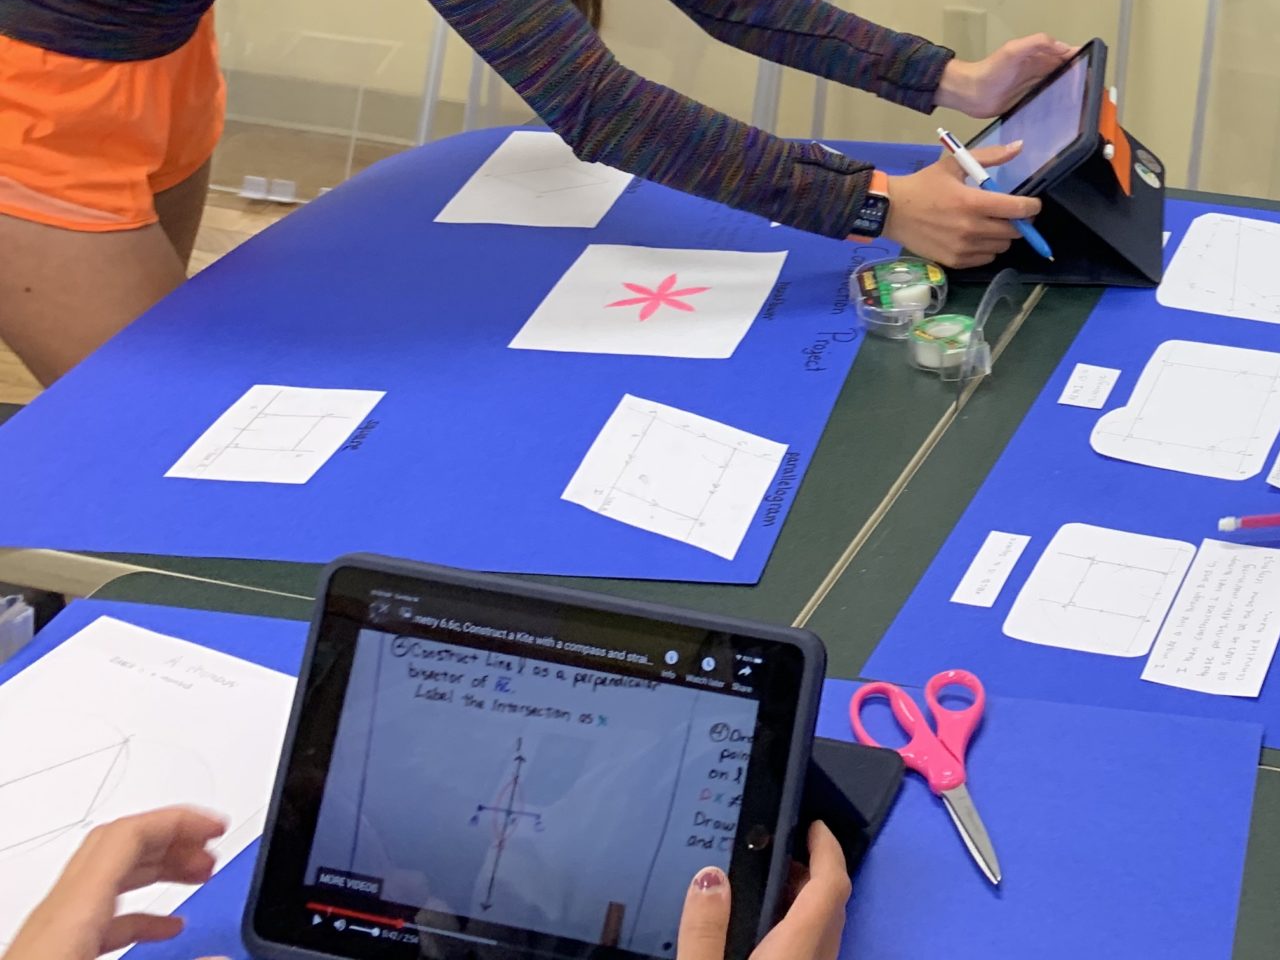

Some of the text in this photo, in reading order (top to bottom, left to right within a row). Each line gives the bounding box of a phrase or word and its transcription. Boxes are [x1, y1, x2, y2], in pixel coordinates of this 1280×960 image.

[801, 327, 858, 372] Project
[762, 451, 801, 528] parallelogram
[463, 622, 507, 639] Construct
[536, 635, 555, 648] with
[564, 641, 607, 658] compass
[607, 649, 627, 661] and
[471, 674, 488, 689] of
[573, 671, 661, 693] perpendicular
[462, 693, 485, 710] the
[693, 811, 736, 832] Draw
[686, 835, 715, 849] and
[319, 873, 379, 893] MORE VIDEOS
